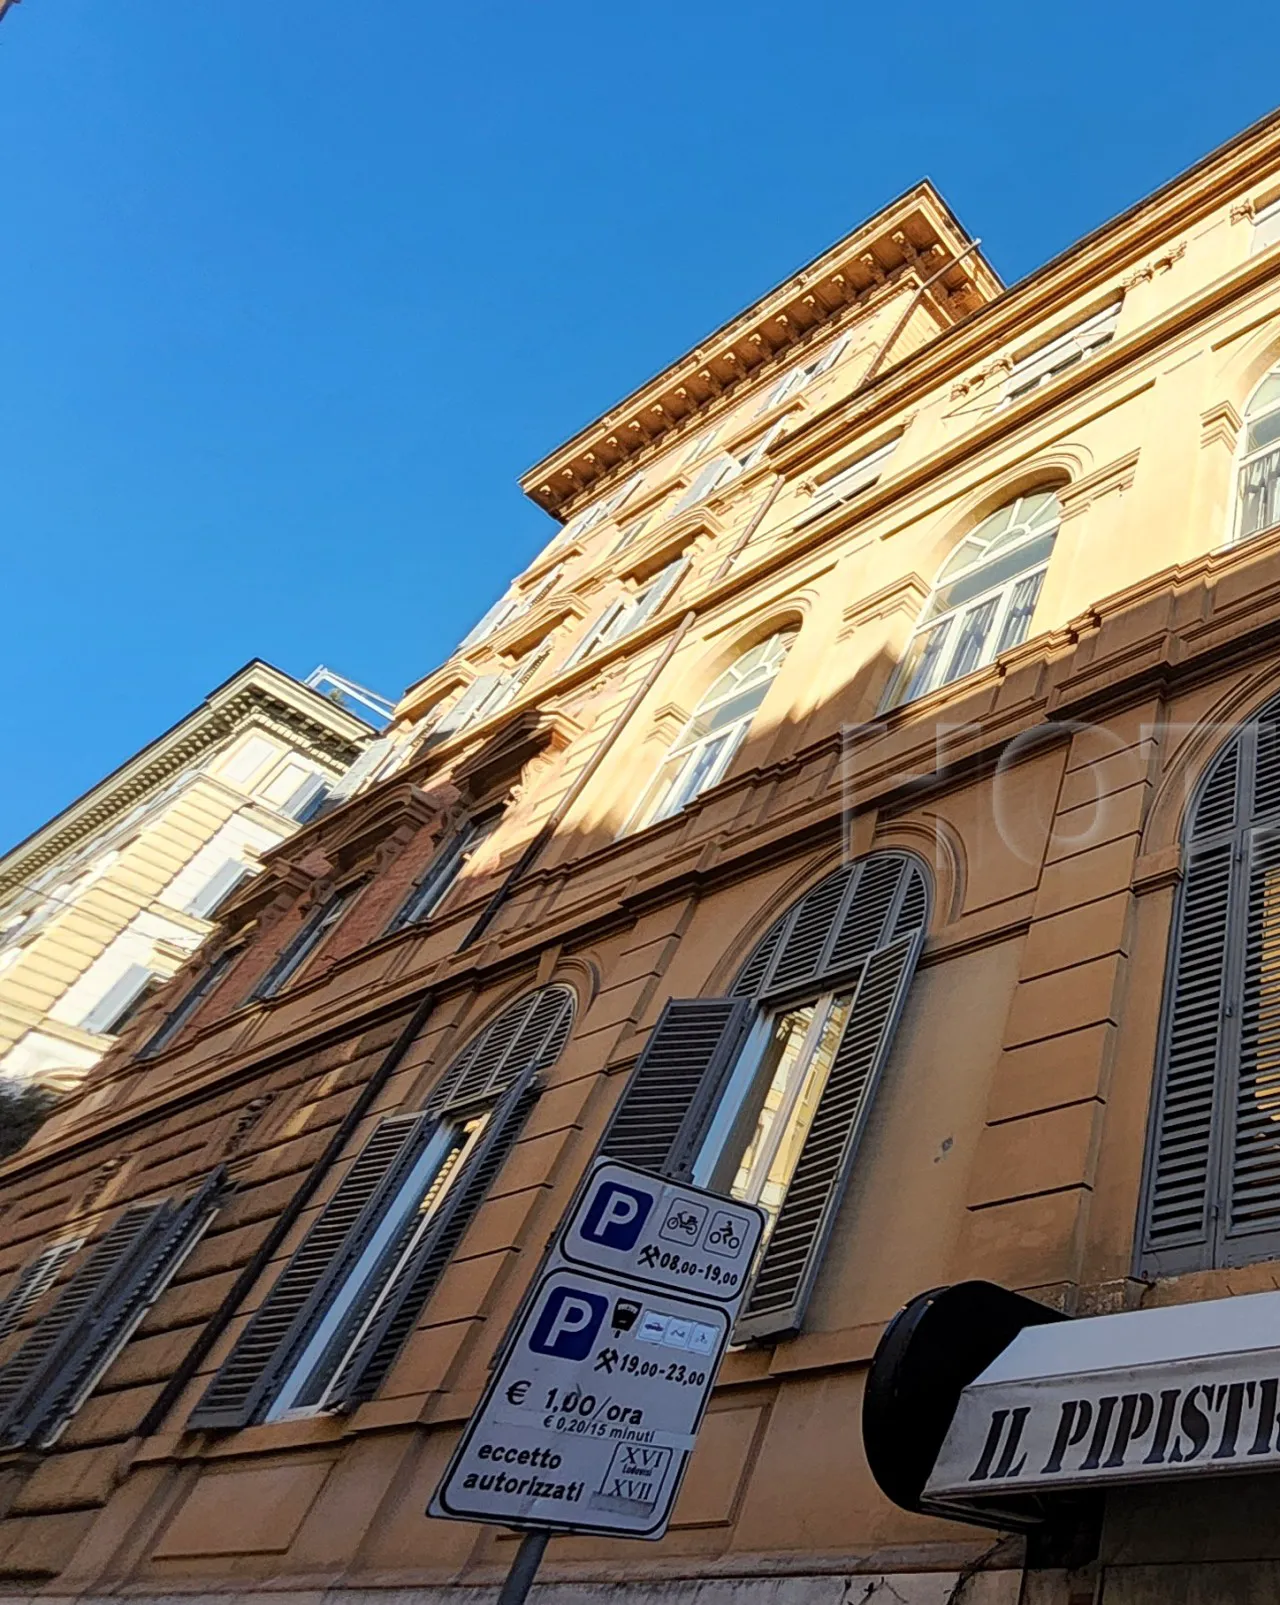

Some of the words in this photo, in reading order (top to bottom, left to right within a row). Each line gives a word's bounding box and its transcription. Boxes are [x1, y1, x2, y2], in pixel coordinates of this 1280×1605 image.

[593, 1189, 638, 1236] P
[660, 1253, 738, 1286] 08,00-19,00
[543, 1295, 593, 1347] P
[619, 1353, 705, 1386] 19,00-23,00
[505, 1380, 532, 1406] €
[544, 1386, 643, 1425] 1,00/ora
[609, 1427, 656, 1443] minuti
[969, 1406, 1031, 1482] IL
[478, 1443, 562, 1470] eccetto
[620, 1446, 664, 1468] XVI
[462, 1470, 585, 1502] autorizzati
[608, 1478, 653, 1500] XVII
